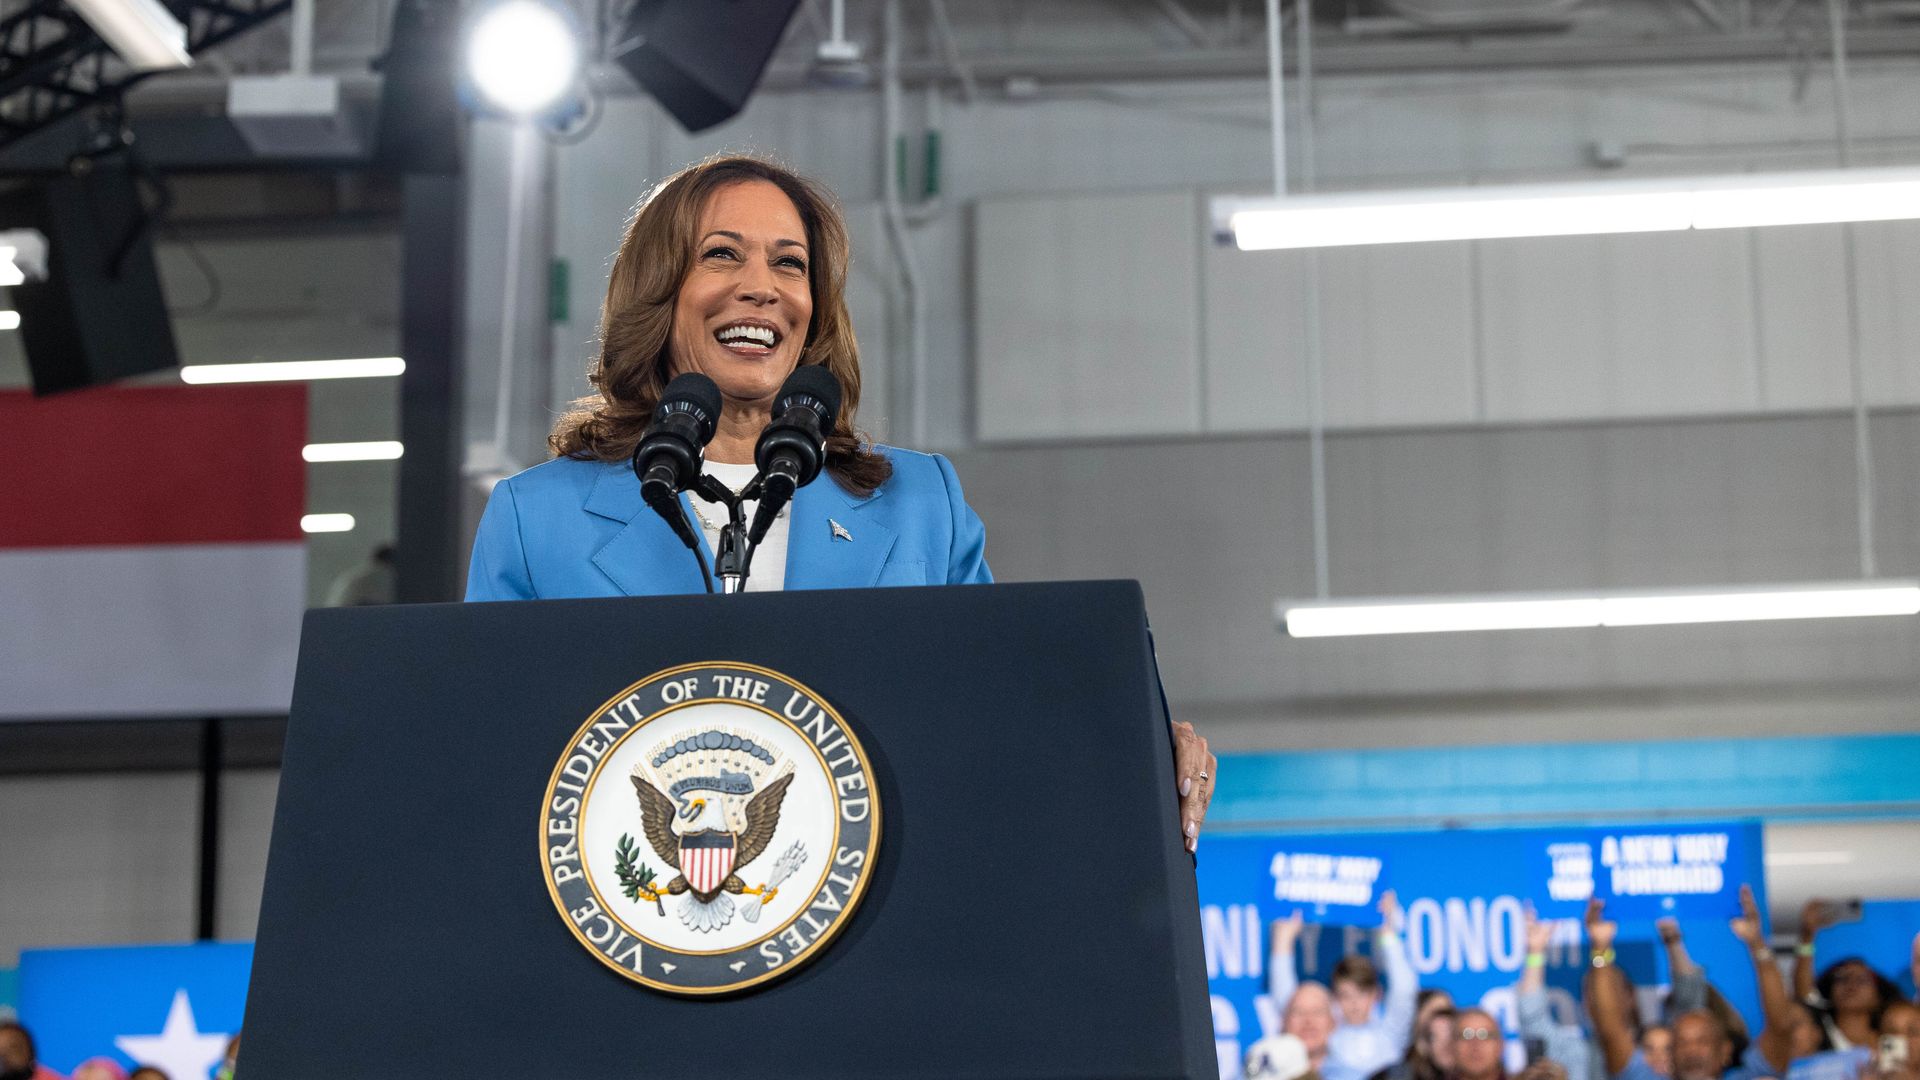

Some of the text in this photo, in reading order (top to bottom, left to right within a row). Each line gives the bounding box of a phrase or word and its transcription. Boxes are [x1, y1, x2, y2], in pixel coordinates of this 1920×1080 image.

[549, 675, 870, 974] VICE PRESIDENT OF THE UNITED STATES
